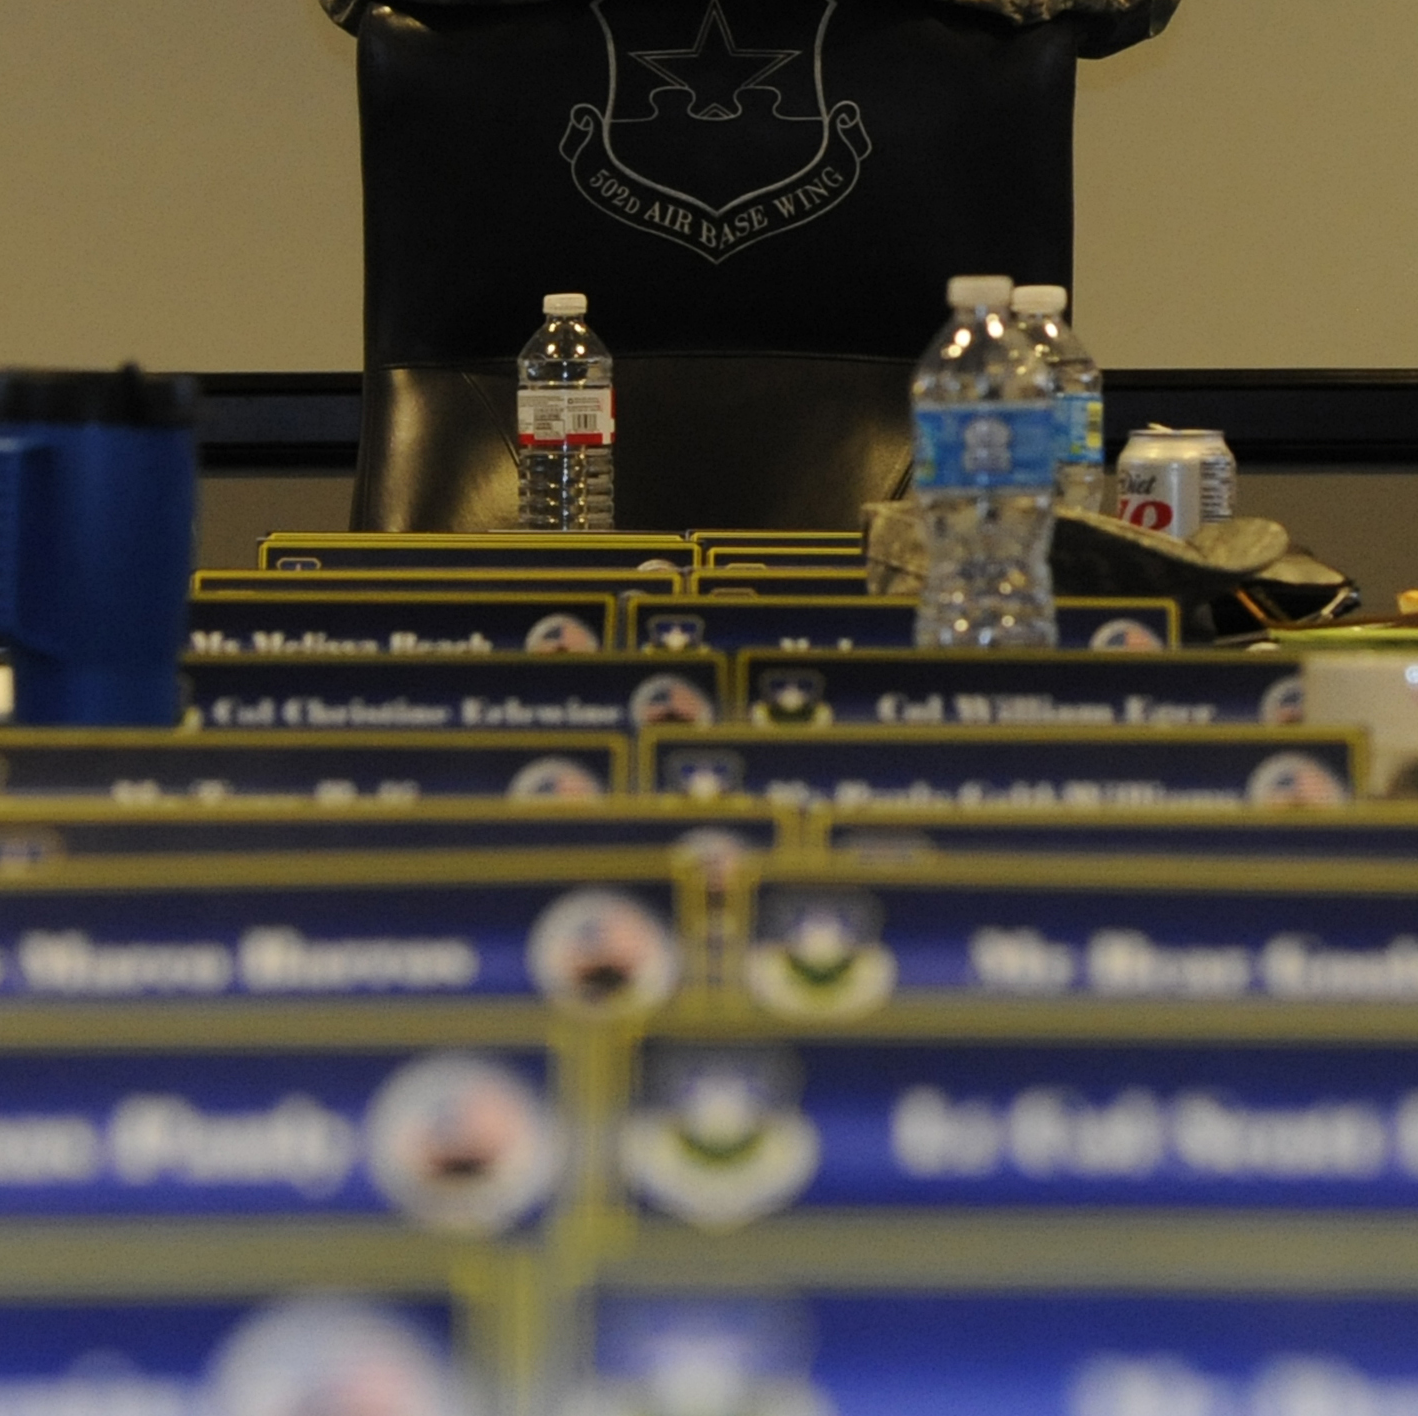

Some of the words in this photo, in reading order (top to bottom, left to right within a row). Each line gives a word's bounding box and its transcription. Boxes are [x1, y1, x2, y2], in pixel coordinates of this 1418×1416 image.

[643, 200, 692, 235] AIR
[698, 205, 769, 251] BASE
[771, 166, 844, 221] WING
